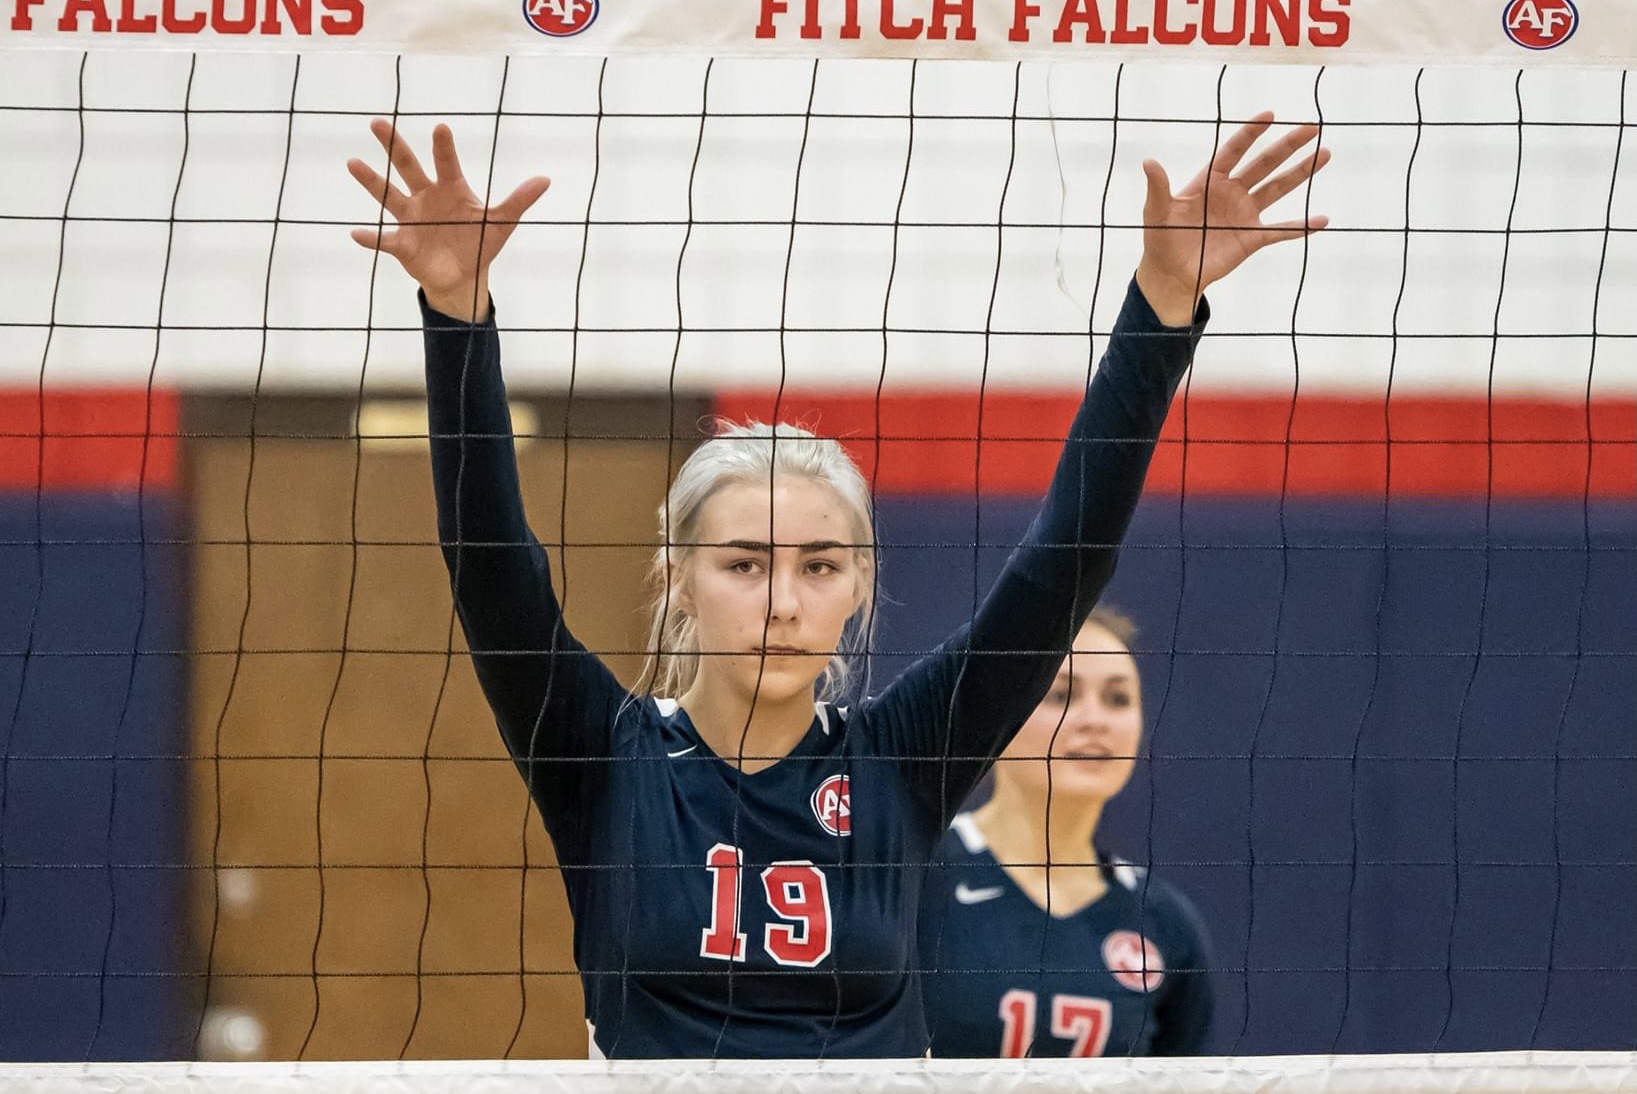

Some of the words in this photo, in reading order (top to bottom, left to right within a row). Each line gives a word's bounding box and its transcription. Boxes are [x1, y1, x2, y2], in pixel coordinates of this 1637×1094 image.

[1008, 0, 1350, 47] FALCONS
[1508, 0, 1572, 37] AF
[700, 843, 832, 967] 19
[998, 989, 1113, 1058] 17
